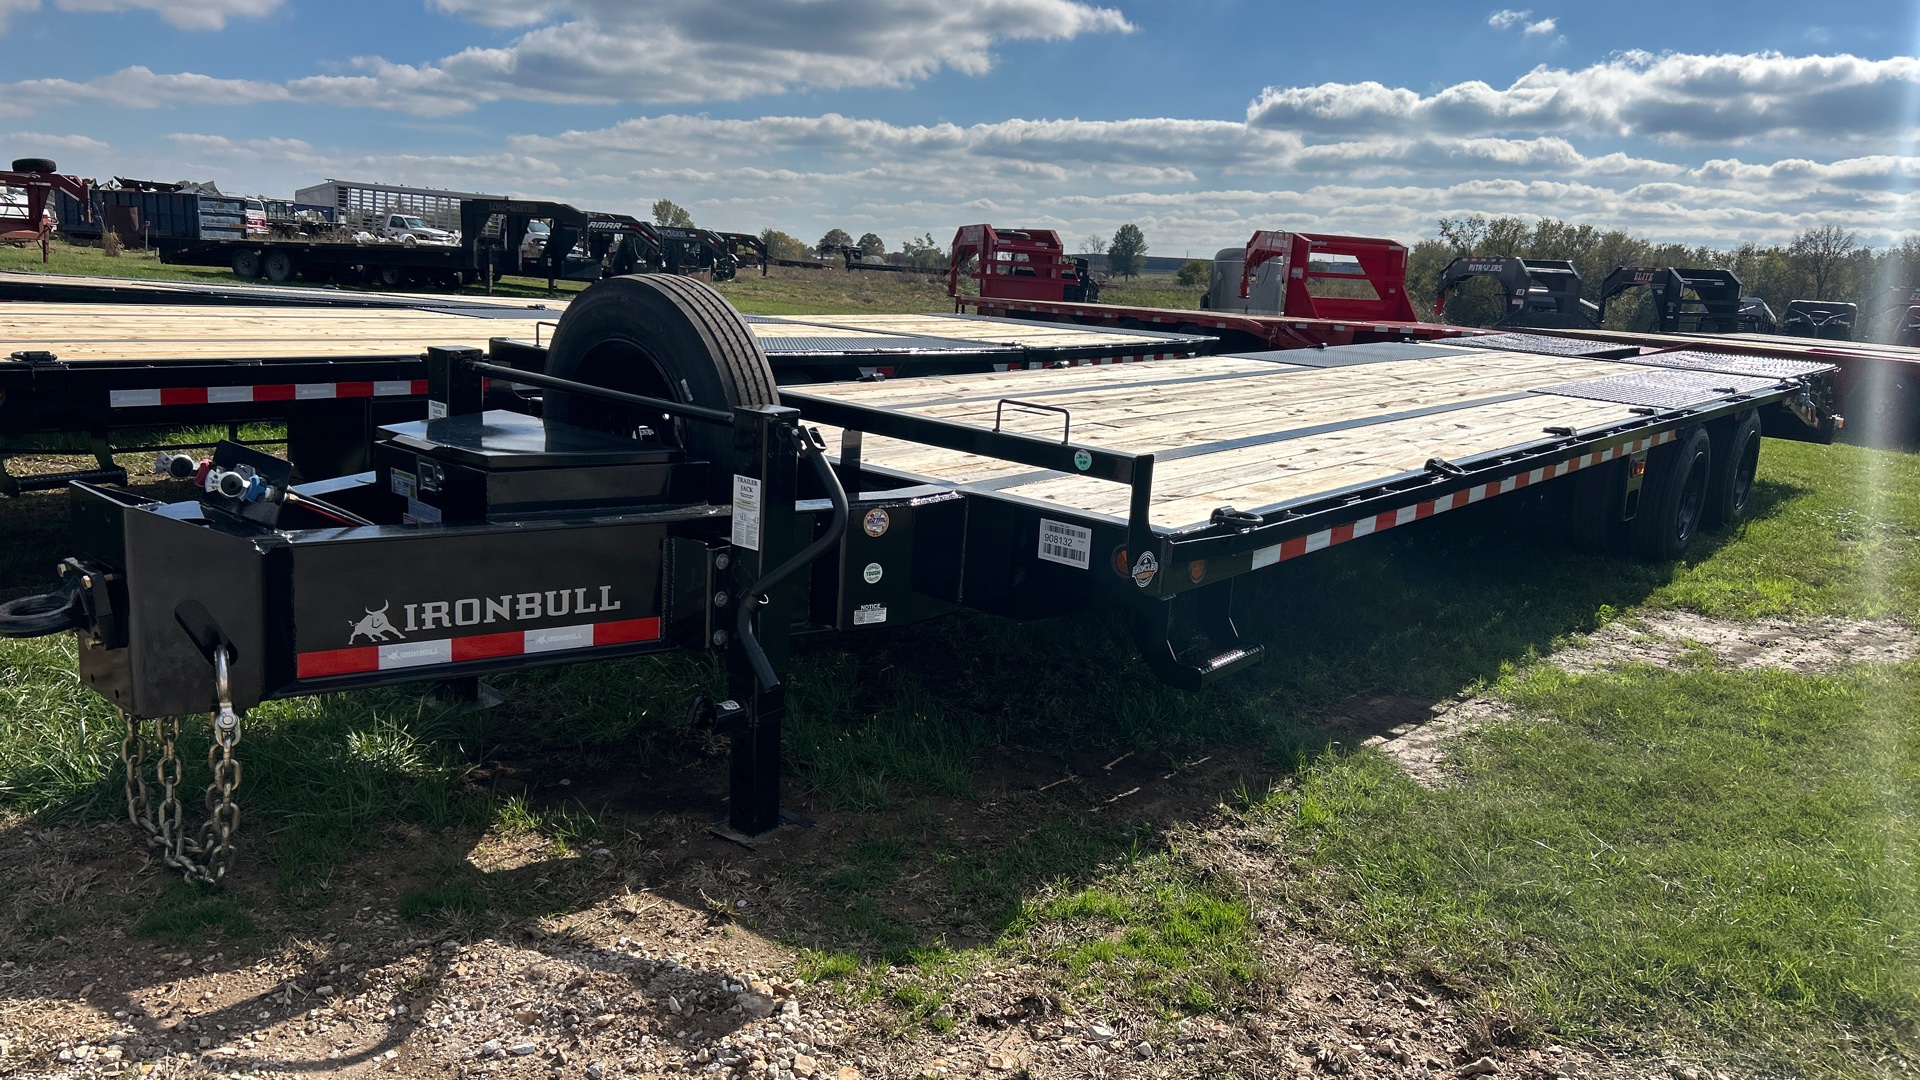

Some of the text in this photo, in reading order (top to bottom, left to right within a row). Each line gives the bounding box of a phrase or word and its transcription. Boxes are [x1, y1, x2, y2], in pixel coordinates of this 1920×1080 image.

[736, 476, 758, 486] TRAILER
[740, 485, 754, 493] JACK
[1044, 533, 1073, 547] 908132
[403, 585, 621, 632] IRONBULL
[860, 603, 881, 611] NOTICE
